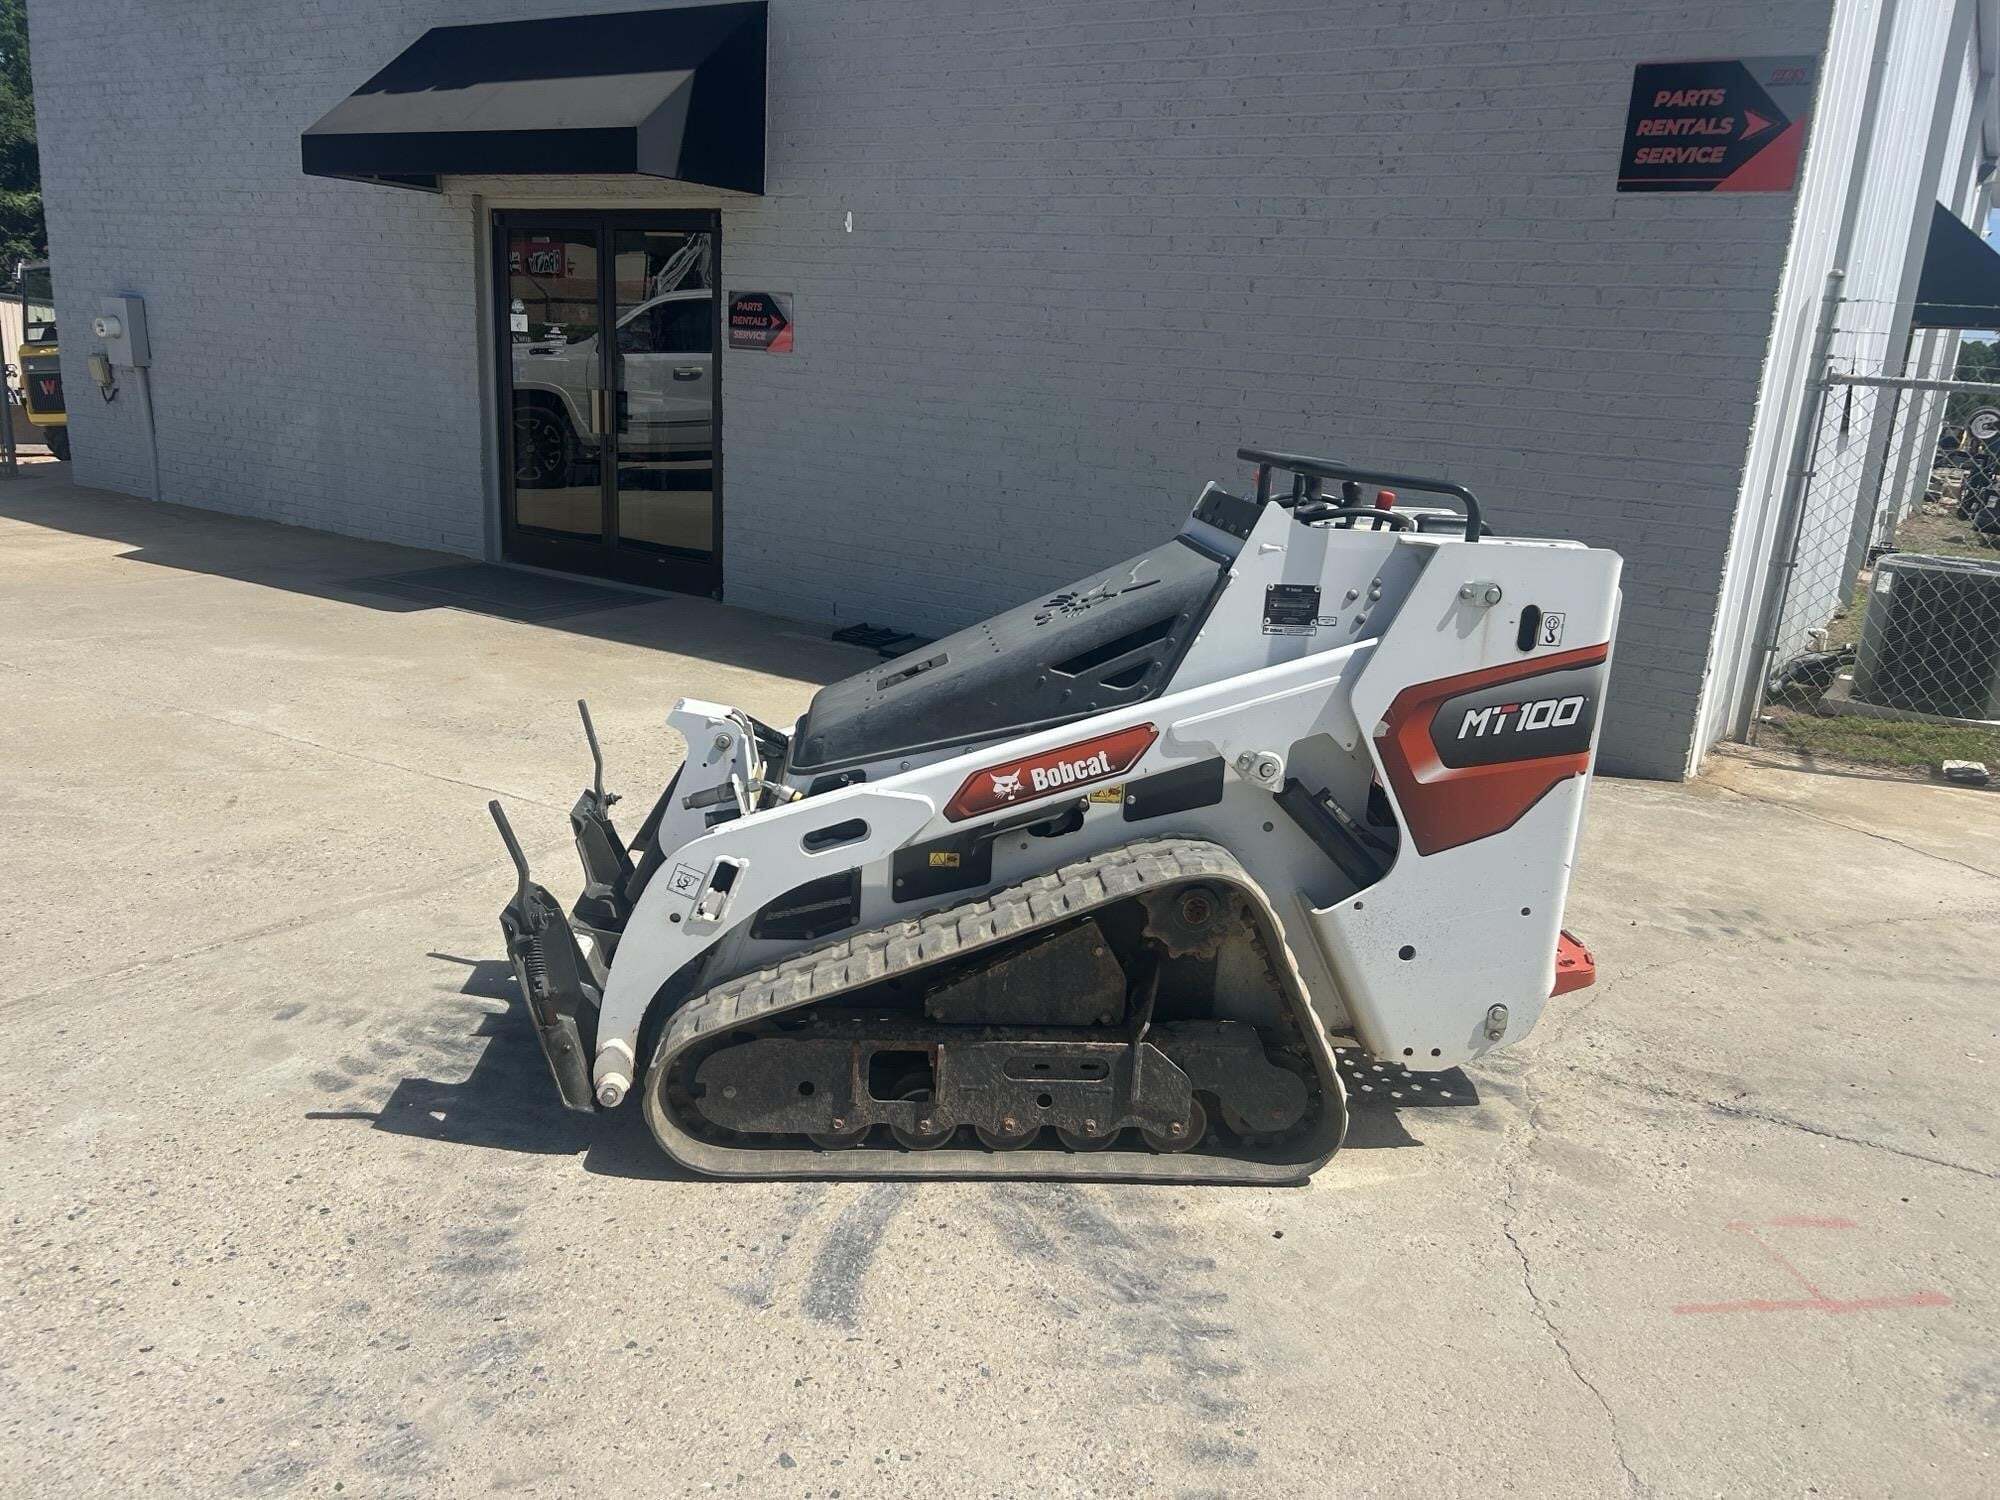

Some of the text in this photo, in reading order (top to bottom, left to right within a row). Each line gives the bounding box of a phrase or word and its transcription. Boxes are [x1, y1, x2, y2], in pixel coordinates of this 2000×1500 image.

[1654, 88, 1727, 107] PARTS
[1636, 117, 1735, 136] RENTALS
[1634, 146, 1727, 164] SERVICE
[736, 301, 763, 311] PARTS
[732, 315, 768, 326] RENTALS
[733, 330, 767, 341] SERVICE
[1457, 695, 1585, 740] MT100
[1030, 750, 1111, 792] Bobcat
